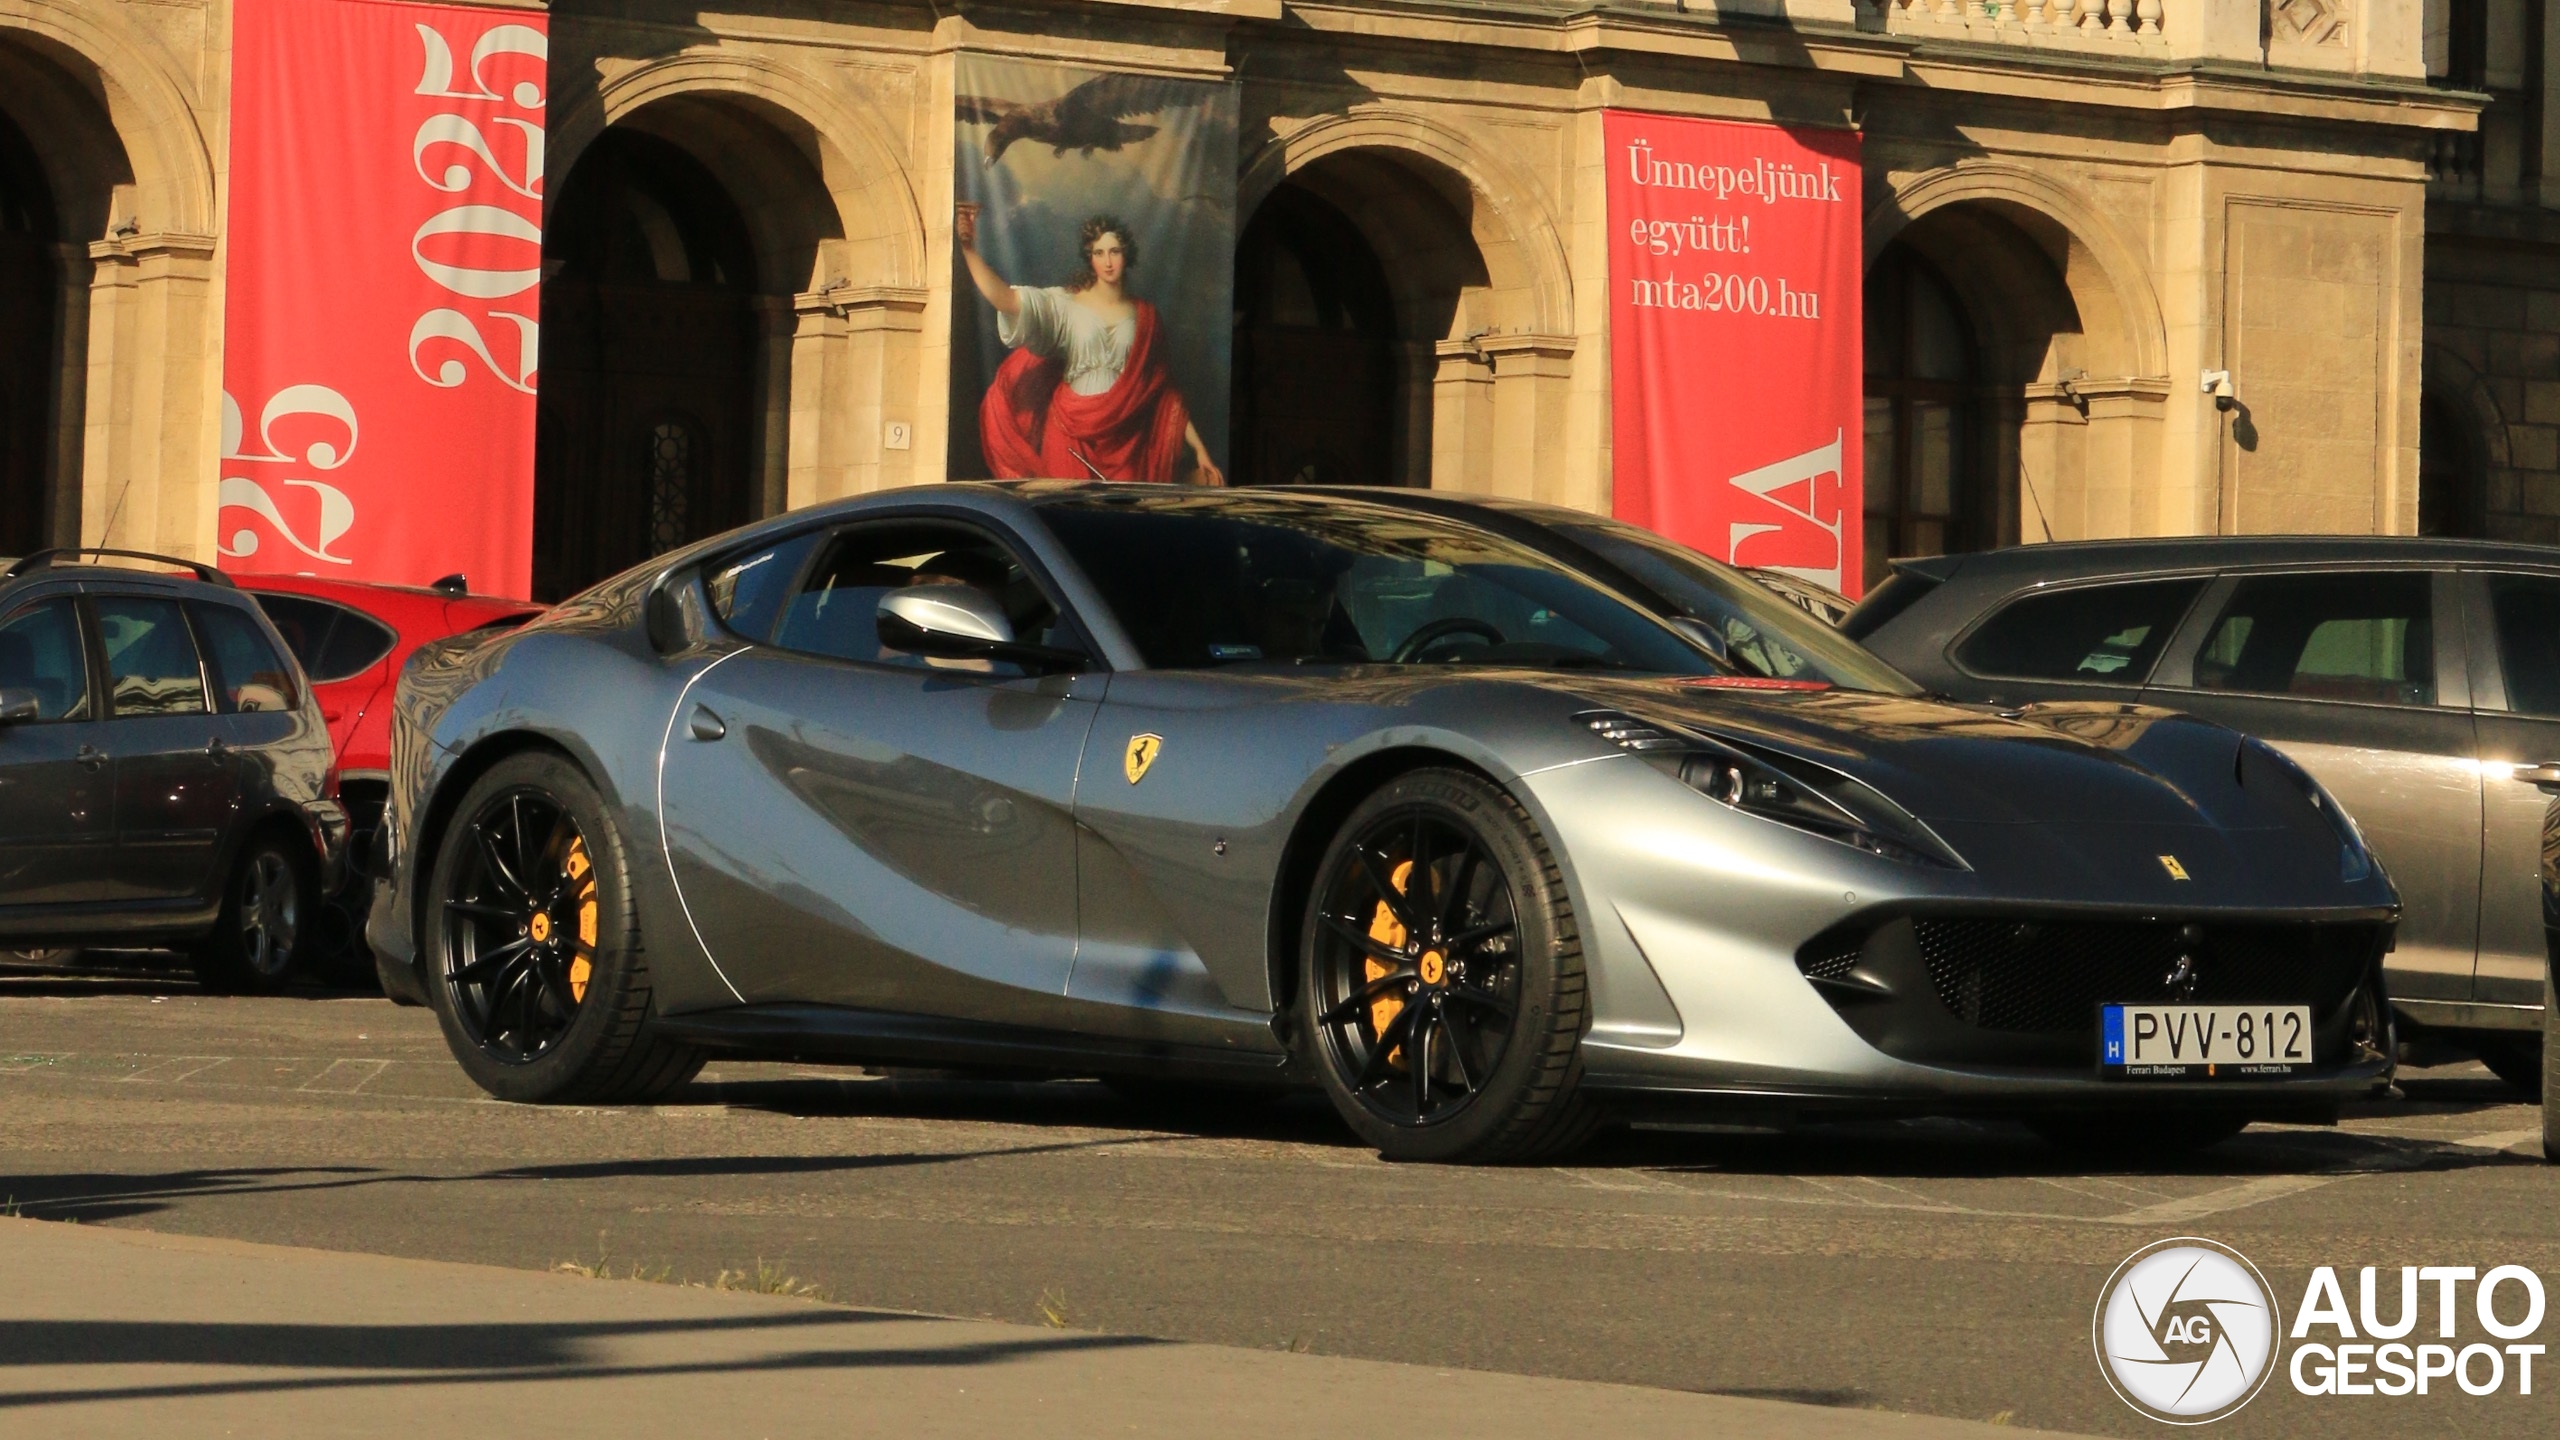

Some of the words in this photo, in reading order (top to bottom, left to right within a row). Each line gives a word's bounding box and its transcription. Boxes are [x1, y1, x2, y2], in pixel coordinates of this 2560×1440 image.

[1628, 138, 1841, 205] Ünnepeljünk
[409, 23, 548, 395] 2025
[1630, 215, 1750, 257] együtt!
[1631, 272, 1820, 320] mta200.hu
[893, 425, 904, 444] 9
[217, 384, 358, 576] 25
[2108, 1041, 2119, 1058] H
[2134, 1011, 2302, 1059] PVV-812
[2126, 1065, 2151, 1075] Ferrari
[2153, 1064, 2186, 1077] Budapest
[2240, 1064, 2292, 1074] www.ferrari.hu
